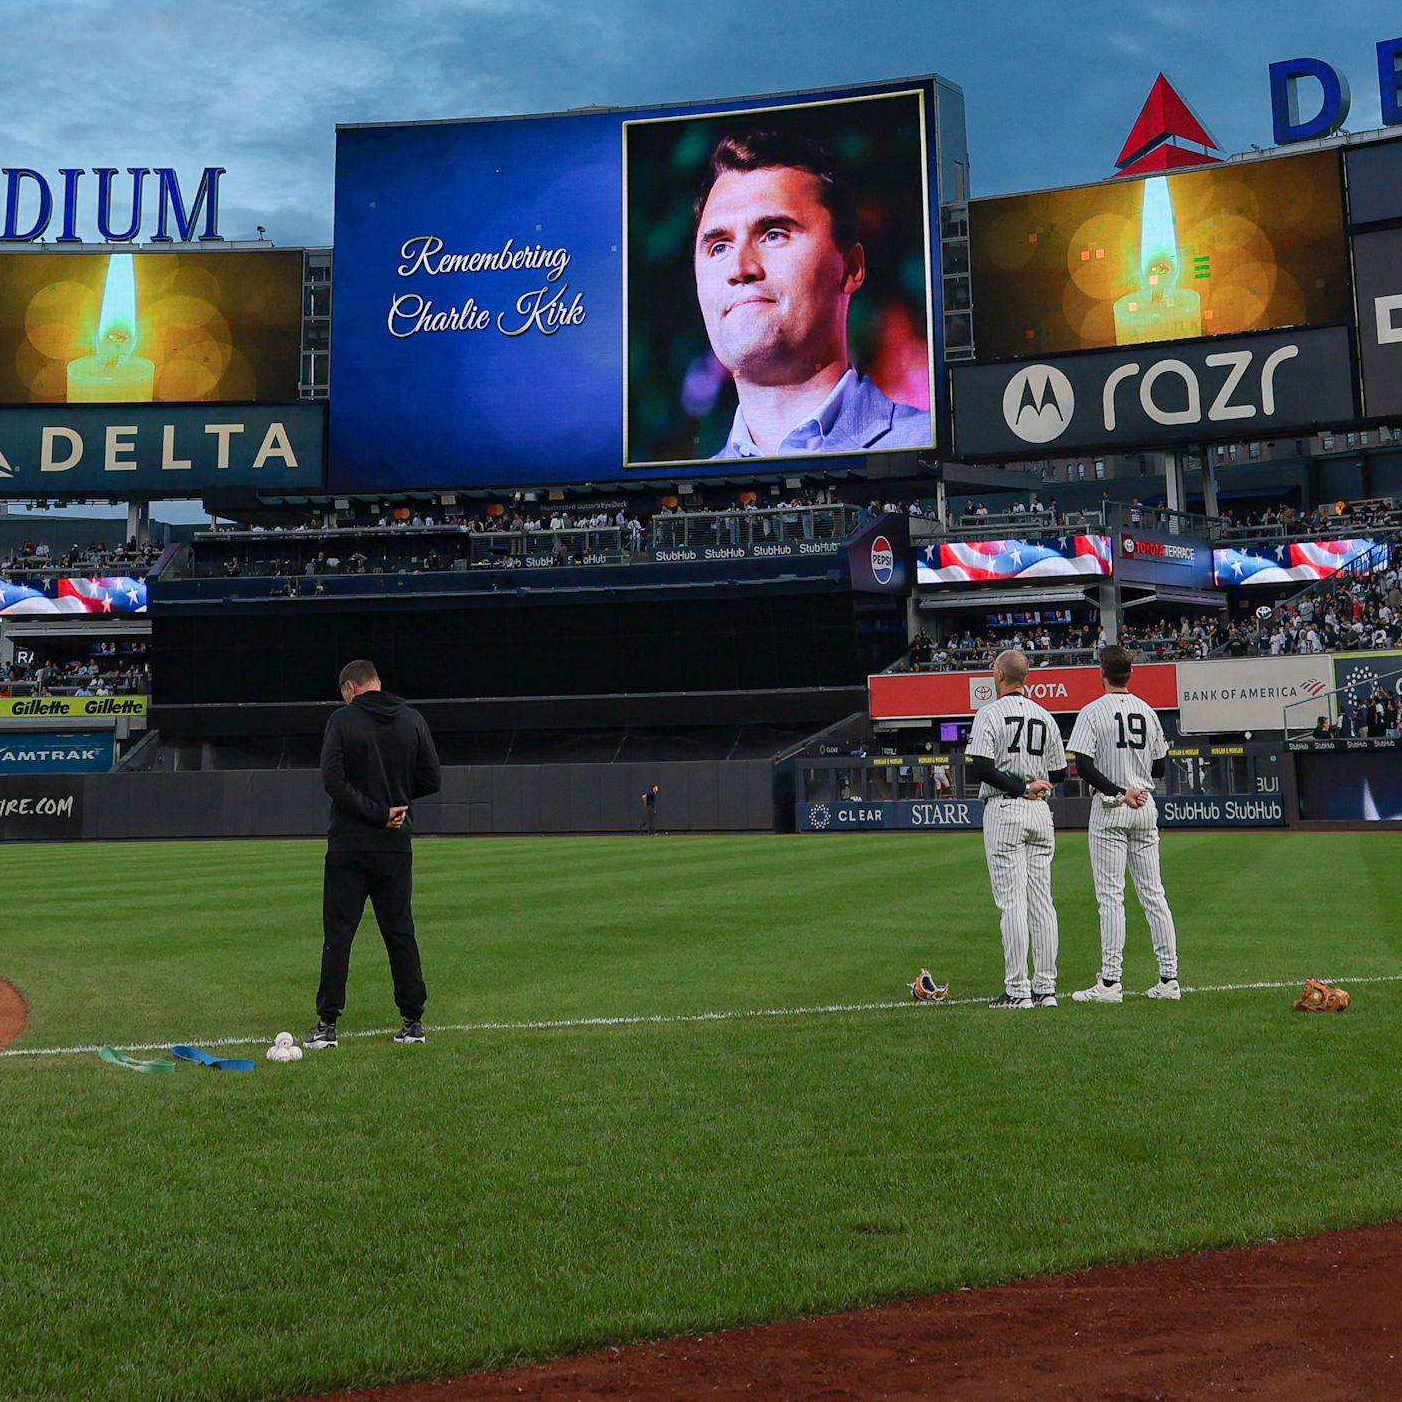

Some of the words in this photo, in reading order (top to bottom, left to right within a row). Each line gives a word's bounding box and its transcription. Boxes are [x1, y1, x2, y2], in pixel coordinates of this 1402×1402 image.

[397, 235, 571, 283] Remembering
[387, 293, 491, 338] Charlie
[497, 283, 586, 336] Kirk
[1102, 344, 1299, 432] razr
[39, 421, 299, 473] DELTA
[656, 550, 697, 561] StubHub
[705, 547, 745, 559] StubHub
[753, 545, 792, 557] StubHub
[799, 542, 838, 555] StubHub
[1134, 541, 1165, 556] TOYOTA
[1164, 544, 1195, 560] TERRACE
[872, 553, 892, 566] PEPSI
[1022, 683, 1069, 699] YOTA
[1184, 689, 1217, 702] BANK
[1221, 688, 1237, 700] OF
[1239, 686, 1297, 699] AMERICA
[11, 699, 71, 715] Gillette
[84, 698, 144, 714] Gillette
[1004, 716, 1047, 756] 70
[1114, 712, 1147, 749] 19
[1, 750, 96, 762] AMTRAK
[838, 809, 882, 822] CLEAR
[911, 804, 971, 825] STARR
[1164, 800, 1220, 821] StubHub
[1225, 800, 1282, 820] StubHub
